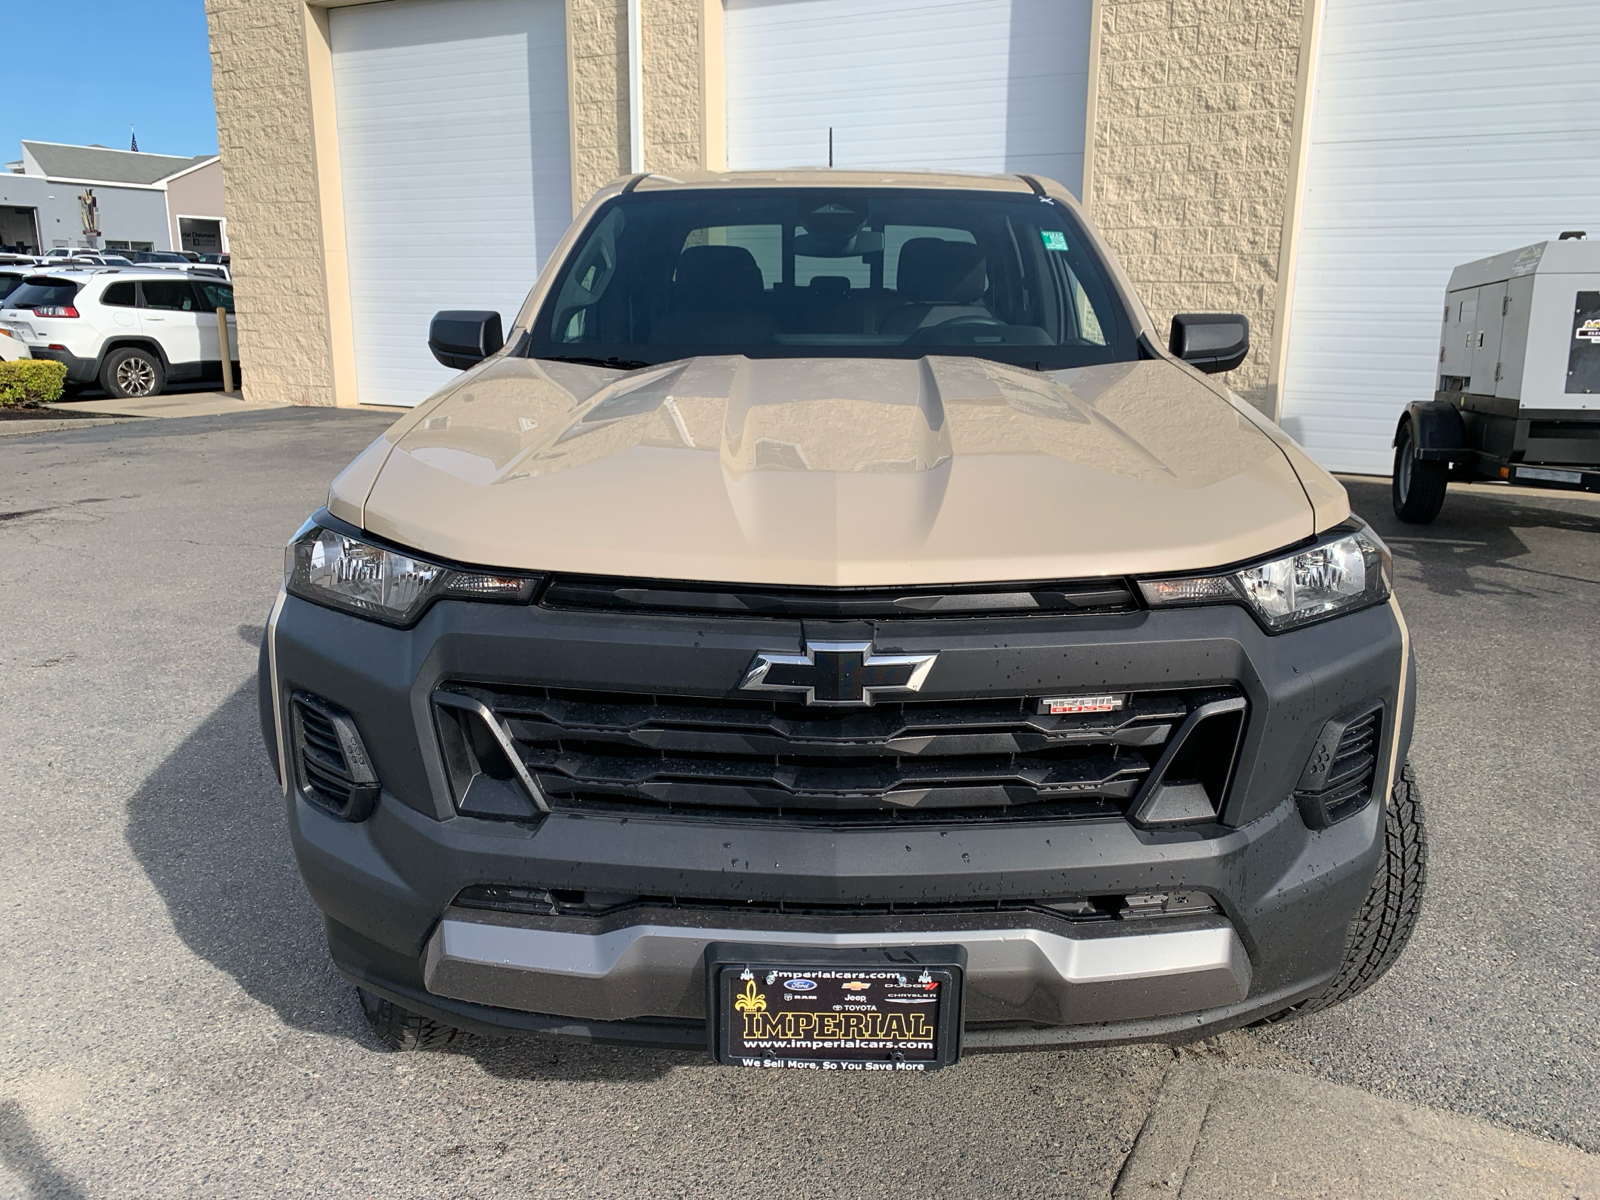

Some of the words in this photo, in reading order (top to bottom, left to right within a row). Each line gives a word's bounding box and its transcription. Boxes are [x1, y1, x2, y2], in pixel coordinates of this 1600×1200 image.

[1043, 696, 1122, 706] TRAIL
[1051, 705, 1113, 713] BOSS
[772, 970, 901, 980] Imperialcars.com
[844, 994, 867, 1002] Jeep
[743, 1012, 934, 1040] IMPERIAL
[743, 1040, 934, 1050] www.imperialcars.com
[742, 1058, 761, 1067] We
[763, 1059, 784, 1068] Sell
[788, 1060, 819, 1070] More,
[822, 1061, 837, 1070] So
[840, 1062, 862, 1070] You
[865, 1062, 893, 1071] Save
[896, 1062, 925, 1071] More
